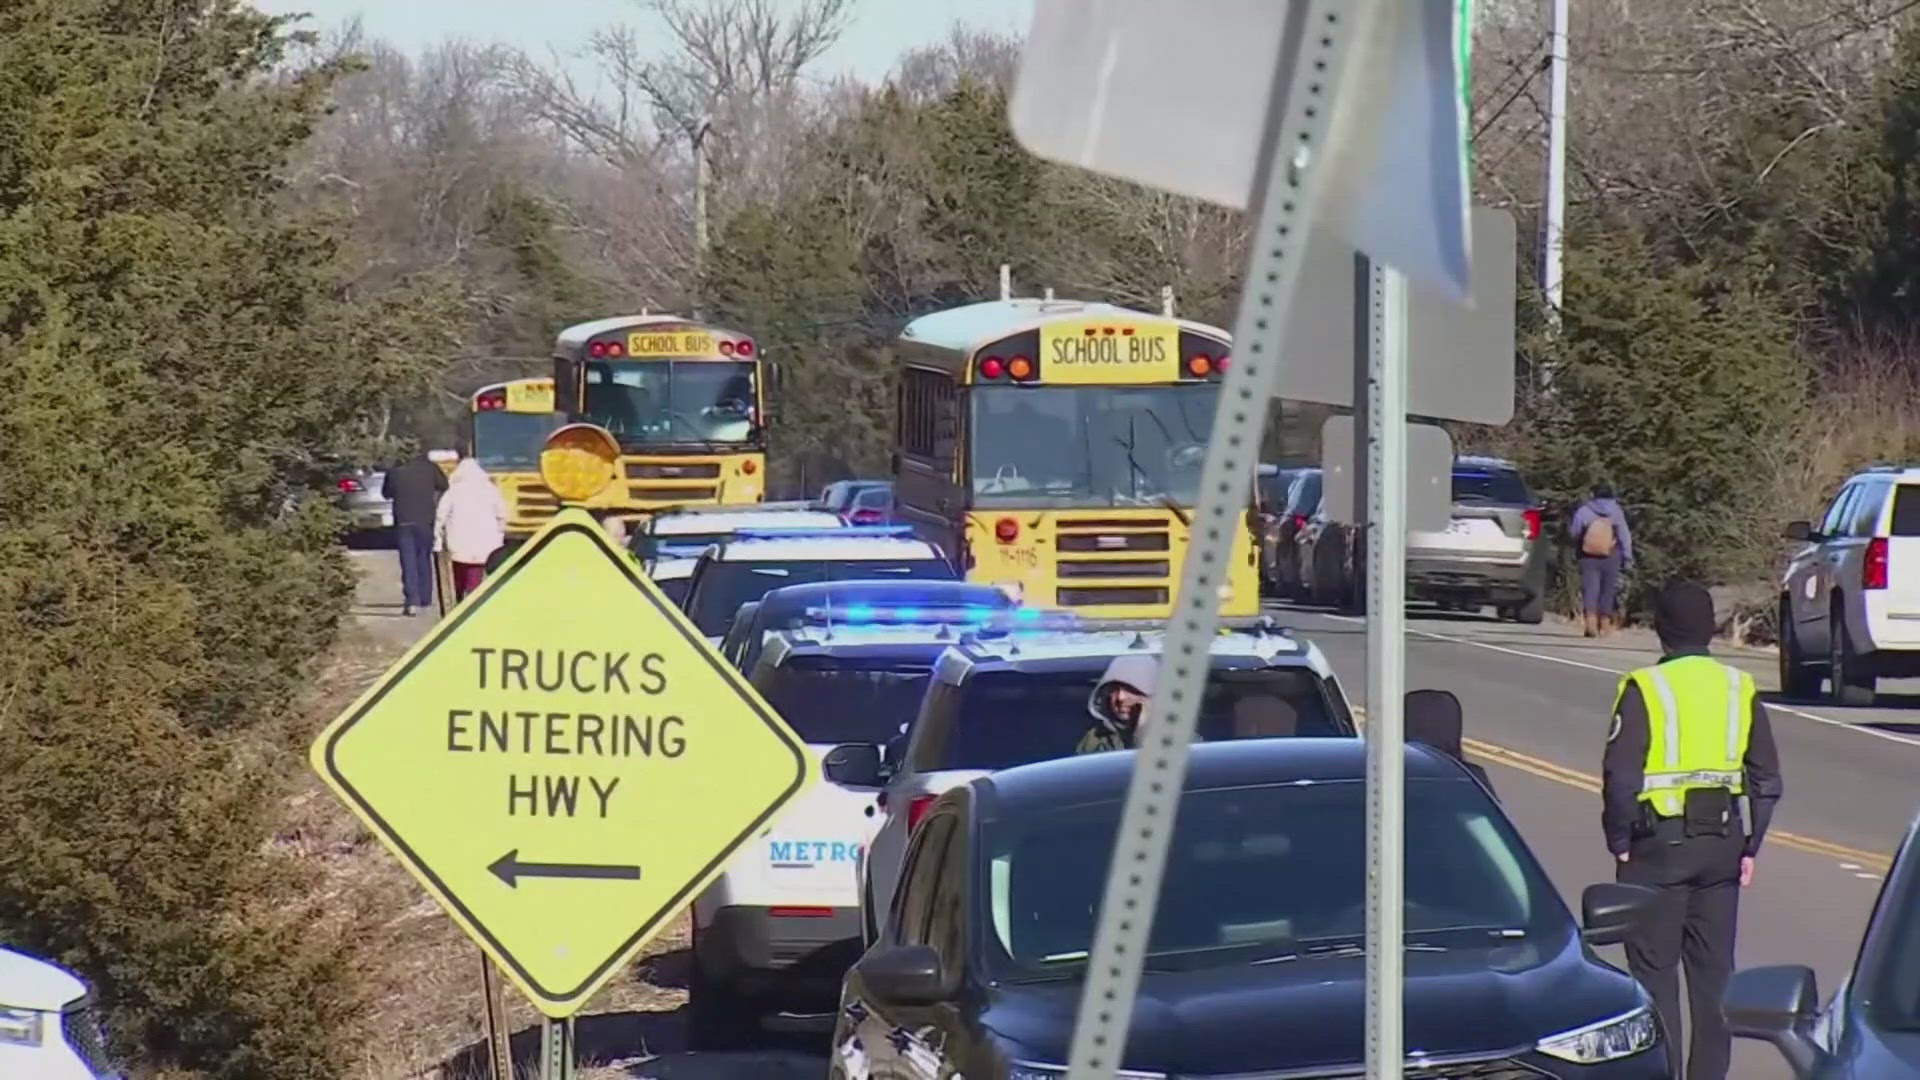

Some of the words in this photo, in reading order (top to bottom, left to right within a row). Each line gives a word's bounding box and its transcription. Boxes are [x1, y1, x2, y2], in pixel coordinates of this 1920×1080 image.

[632, 336, 681, 353] SCHOOL
[685, 336, 710, 353] BUS
[1053, 337, 1123, 364] SCHOOL
[1130, 337, 1166, 363] BUS
[472, 648, 667, 695] TRUCKS
[448, 710, 686, 758] ENTERING
[508, 775, 620, 817] HWY
